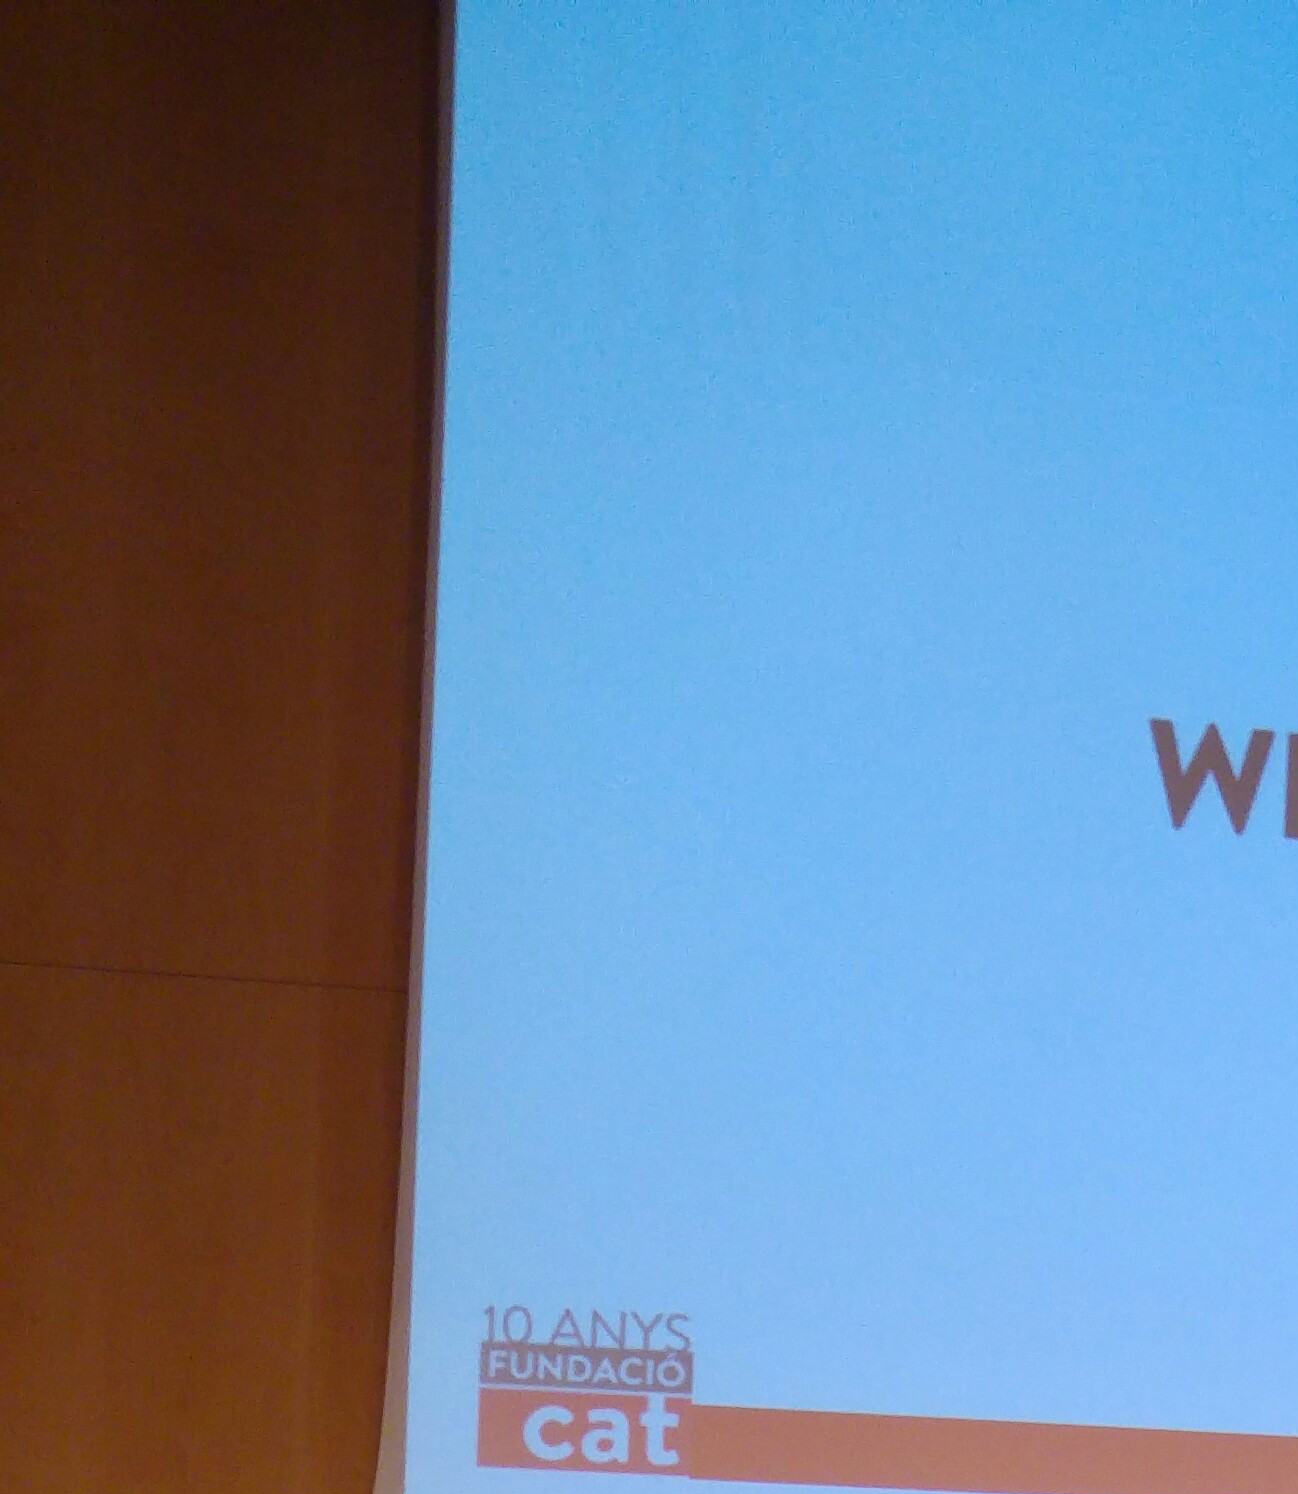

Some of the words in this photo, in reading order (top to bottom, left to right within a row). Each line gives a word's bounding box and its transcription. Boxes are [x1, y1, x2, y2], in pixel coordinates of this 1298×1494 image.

[485, 1304, 533, 1342] 10
[551, 1308, 691, 1350] ANYS
[488, 1350, 685, 1387] FUNDACIÓ
[522, 1395, 680, 1466] cat
